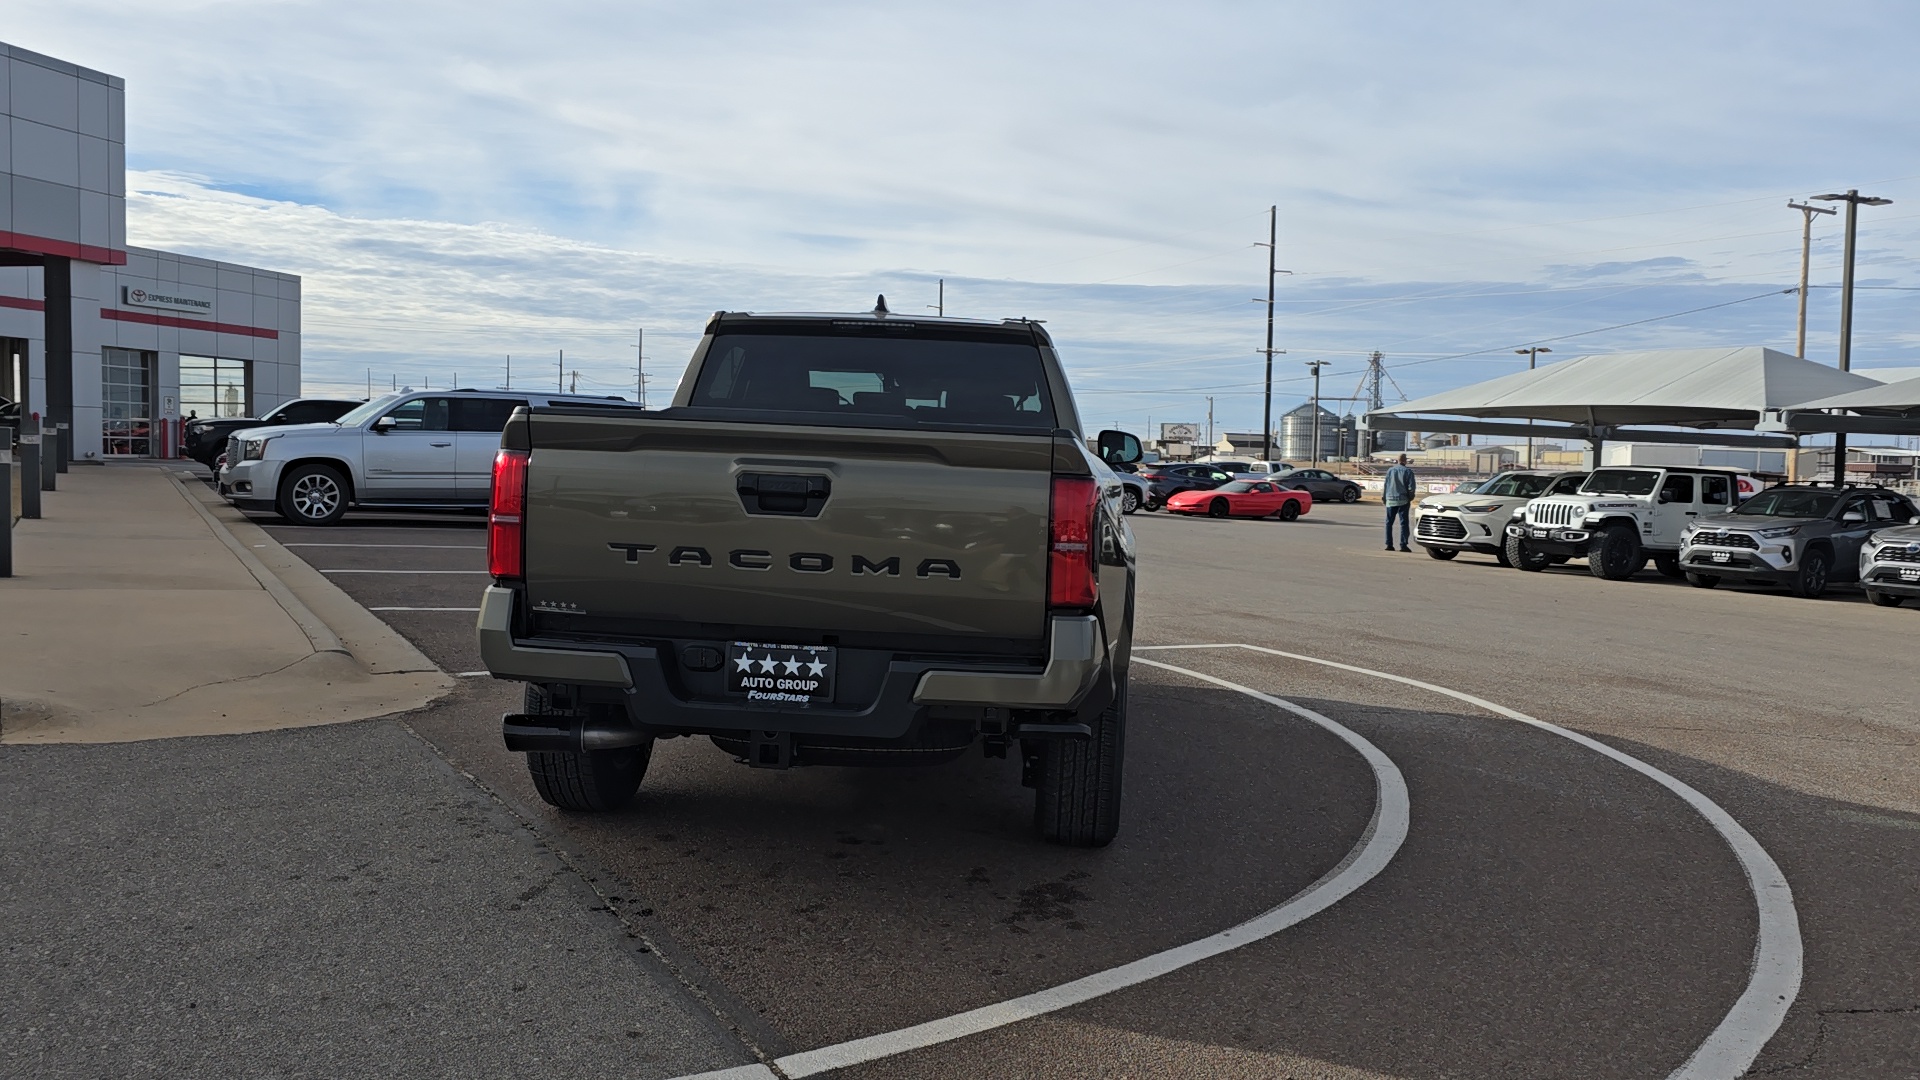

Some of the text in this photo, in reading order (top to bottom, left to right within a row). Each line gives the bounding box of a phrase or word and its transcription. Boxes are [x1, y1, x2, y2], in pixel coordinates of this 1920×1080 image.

[148, 294, 211, 309] EXPRESS MAINTENANCE
[606, 542, 962, 580] TACOMA
[741, 676, 819, 691] AUTO GROUP
